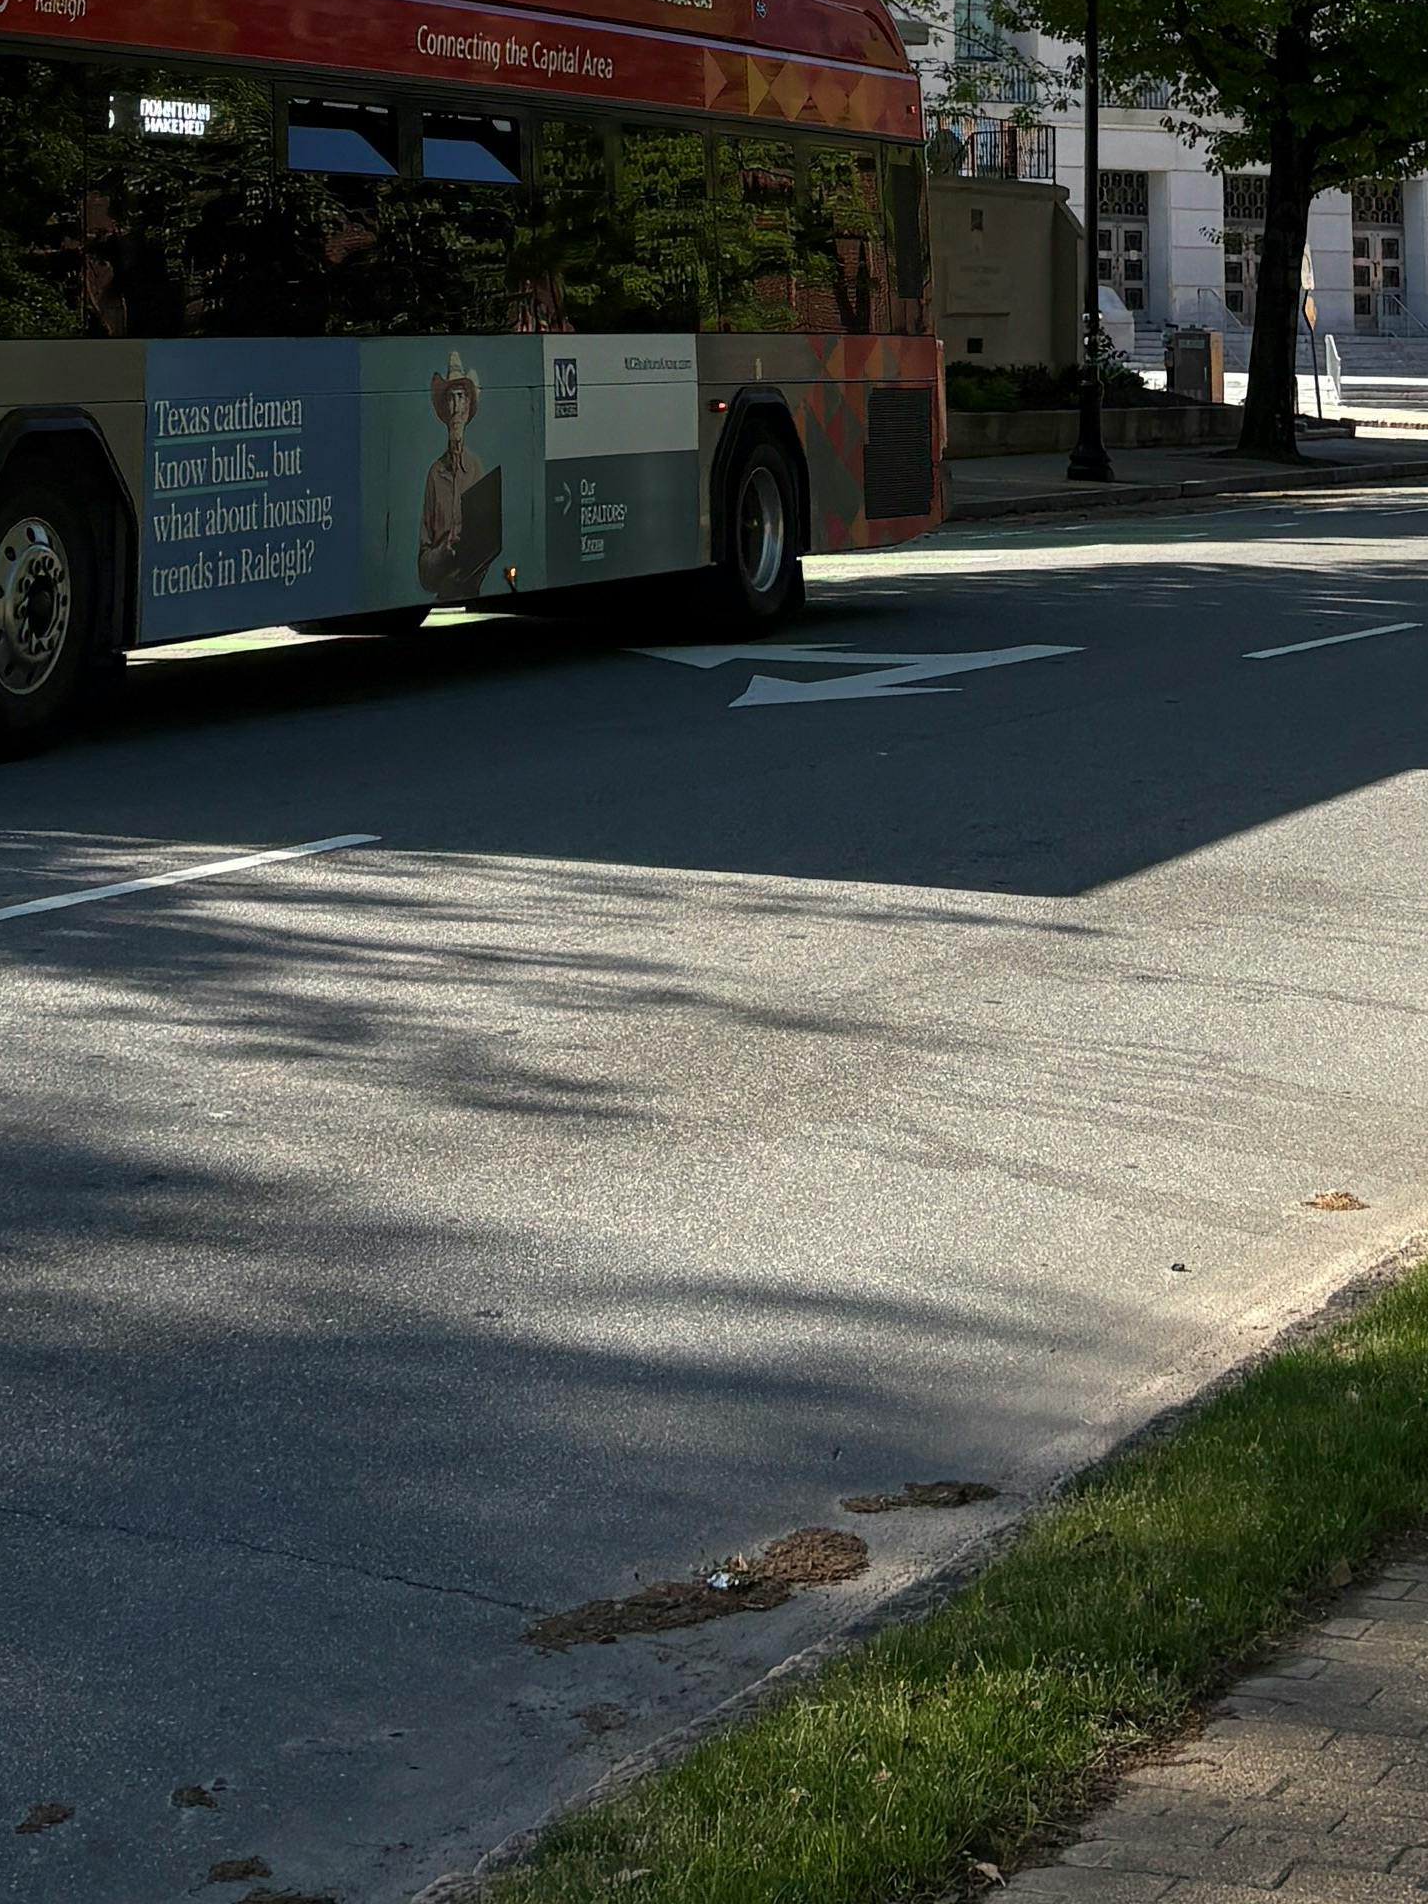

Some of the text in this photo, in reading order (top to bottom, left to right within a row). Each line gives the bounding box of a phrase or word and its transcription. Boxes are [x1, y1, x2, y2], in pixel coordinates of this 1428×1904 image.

[417, 25, 613, 79] Connecting the Capital Area
[140, 98, 211, 122] DOWNTOWN
[555, 364, 576, 398] NC
[154, 393, 303, 437] Texas cattlemen
[154, 440, 303, 490] know bulls... but
[153, 489, 333, 542] what about housing
[152, 538, 315, 597] trends in Raleigh?
